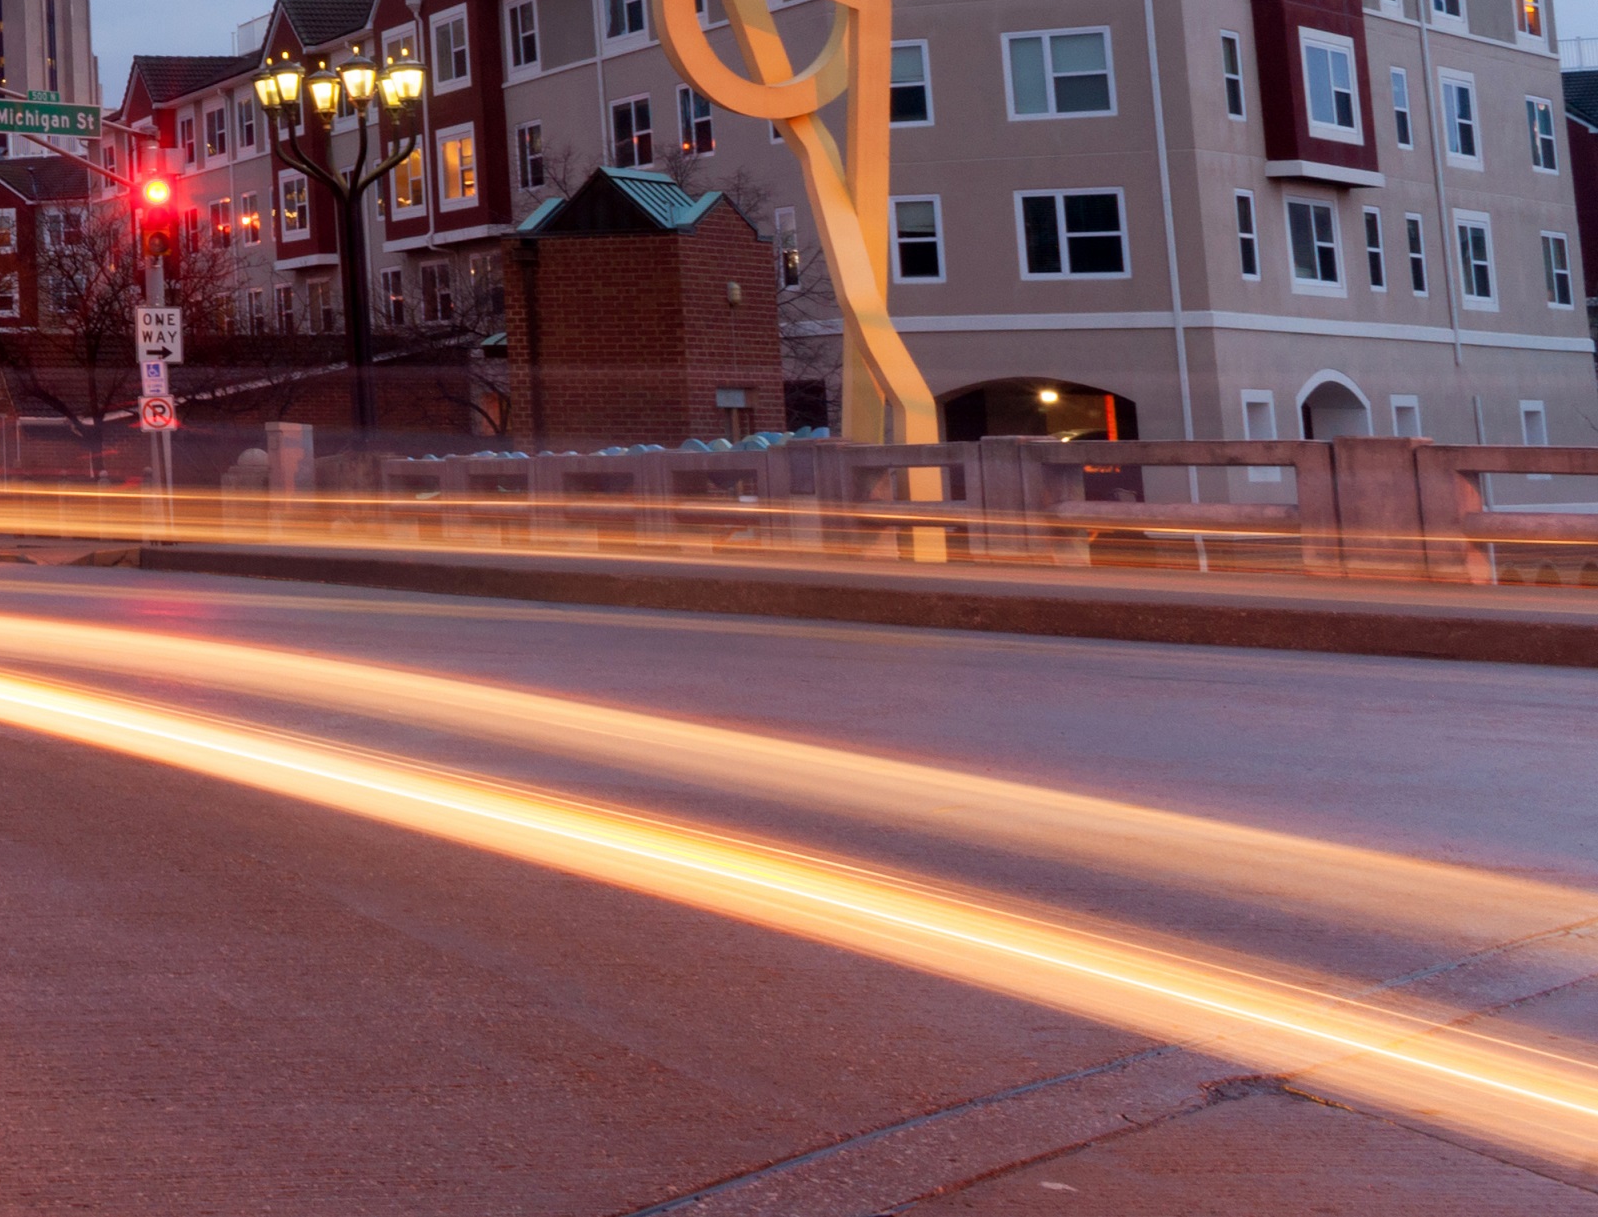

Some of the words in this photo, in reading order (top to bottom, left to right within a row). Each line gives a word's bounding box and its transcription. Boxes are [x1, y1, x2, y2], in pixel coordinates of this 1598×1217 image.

[32, 91, 47, 101] 500
[50, 92, 57, 101] N
[76, 112, 95, 130] St
[142, 313, 176, 326] ONE
[142, 330, 177, 343] WAY
